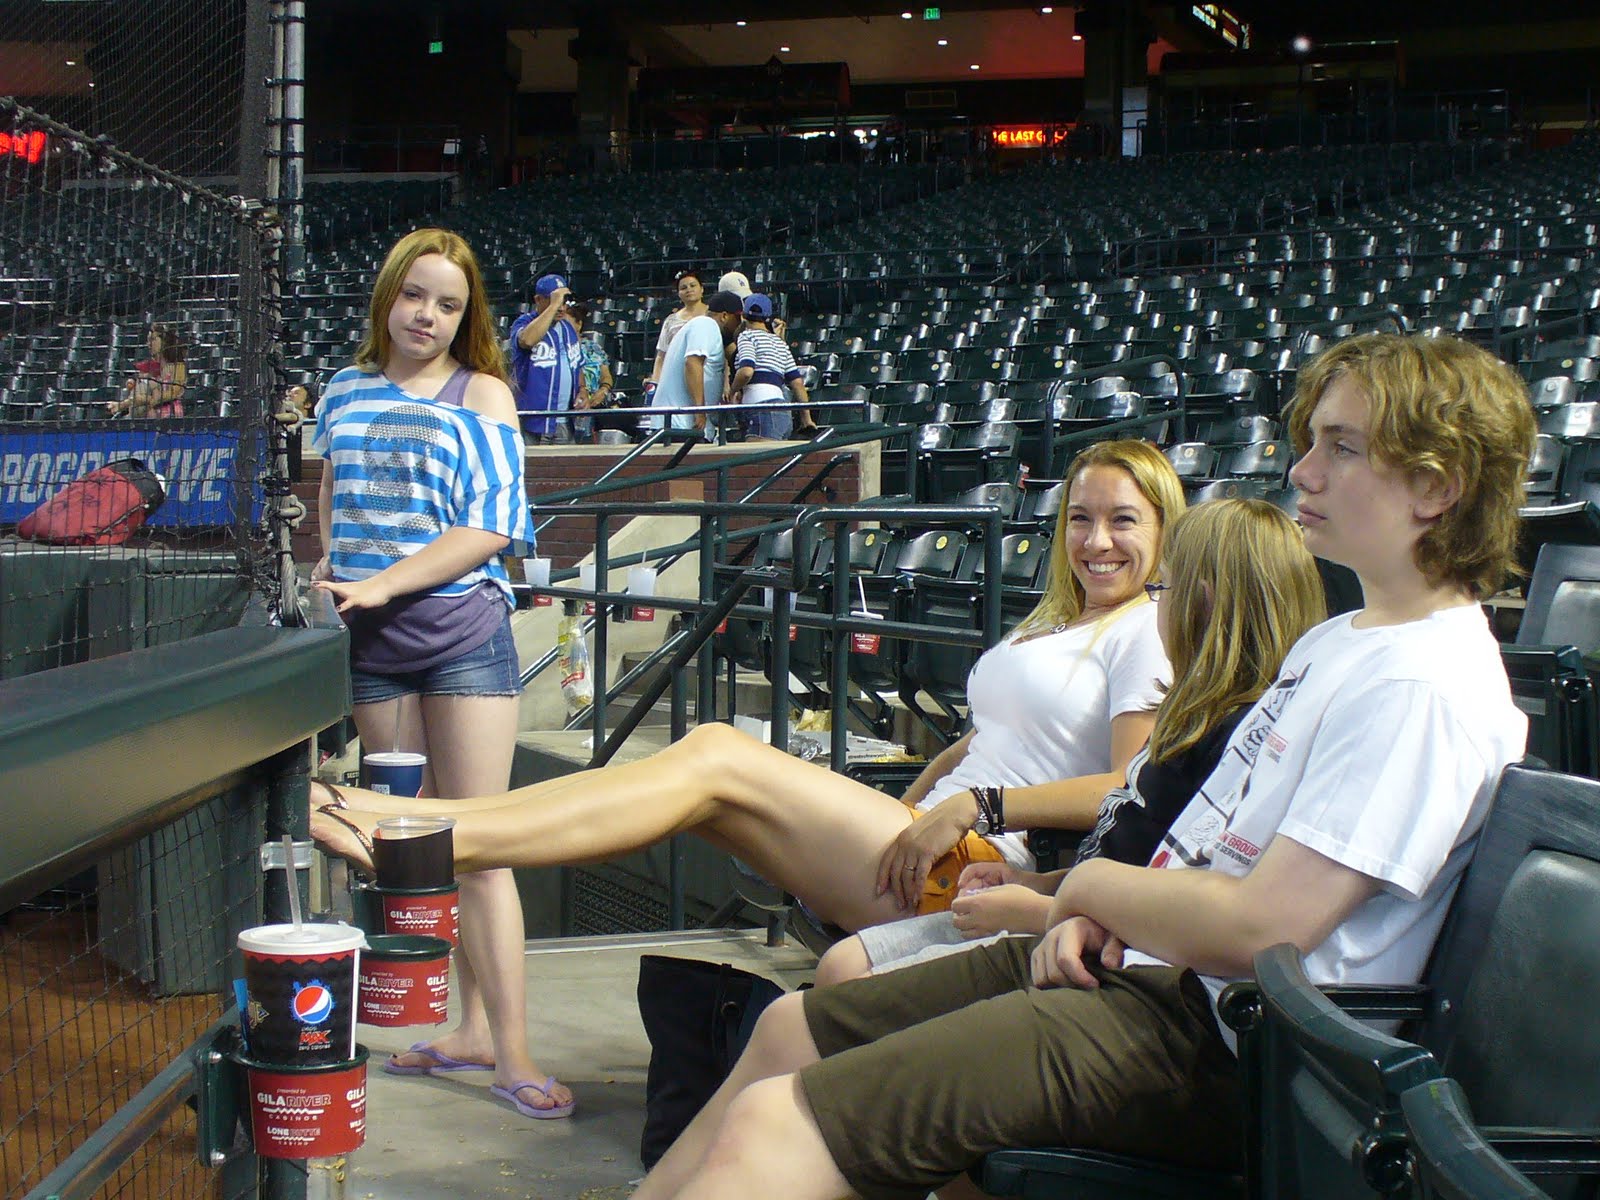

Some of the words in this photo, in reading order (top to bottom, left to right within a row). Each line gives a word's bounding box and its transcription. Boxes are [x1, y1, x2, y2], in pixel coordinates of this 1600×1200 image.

[1010, 131, 1034, 142] LAST
[1227, 837, 1259, 858] GROUP
[1219, 845, 1252, 866] SERVINGS
[389, 910, 412, 919] GILA
[257, 1093, 286, 1106] GILA
[286, 1094, 332, 1107] RIVER
[267, 1126, 289, 1136] LONE
